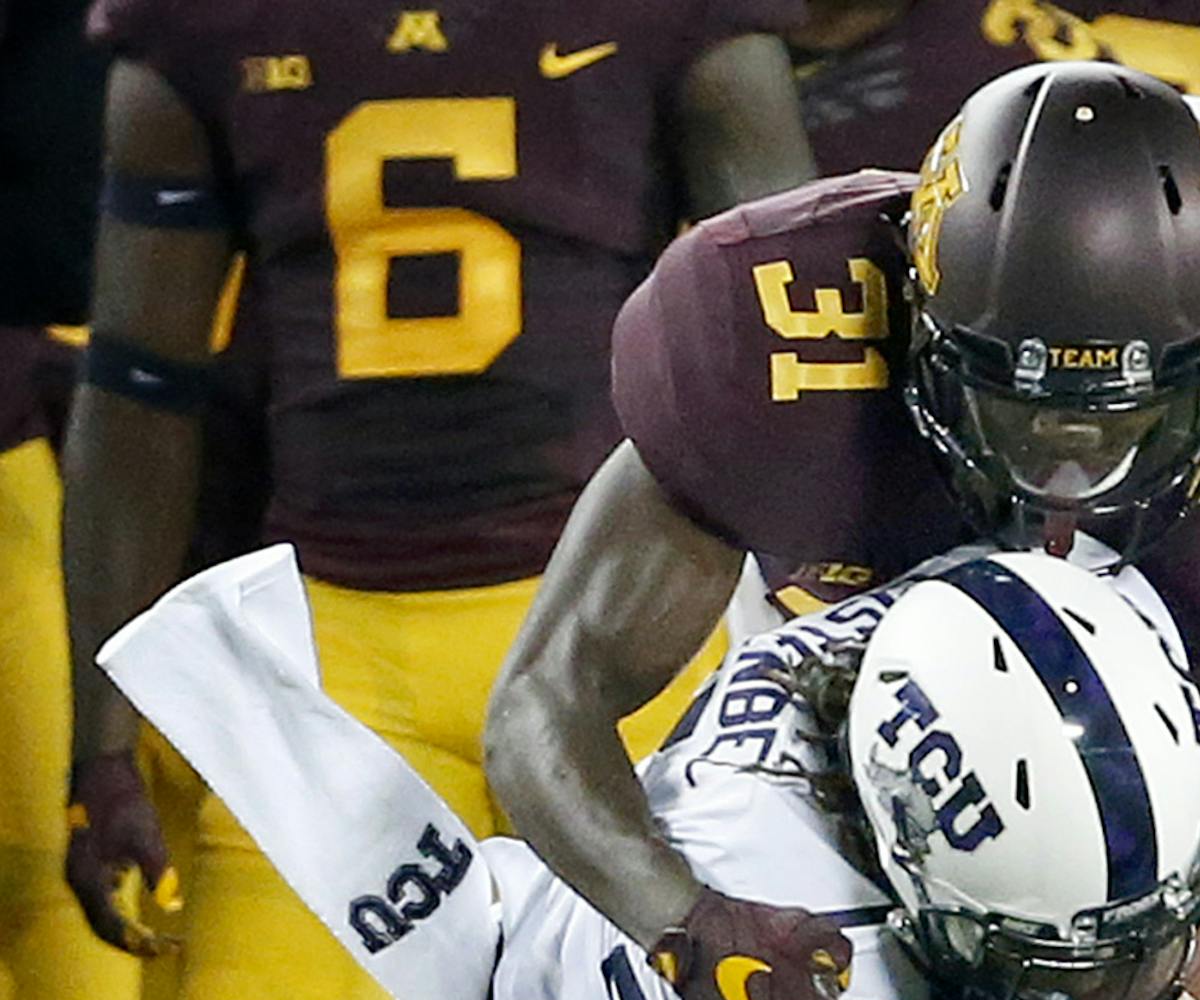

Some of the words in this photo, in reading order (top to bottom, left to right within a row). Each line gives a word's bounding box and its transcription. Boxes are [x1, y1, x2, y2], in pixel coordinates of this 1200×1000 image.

[325, 96, 523, 378] 6
[752, 258, 890, 401] 31
[1049, 347, 1119, 368] TEAM
[877, 678, 1004, 852] TCU
[349, 822, 474, 955] TCU
